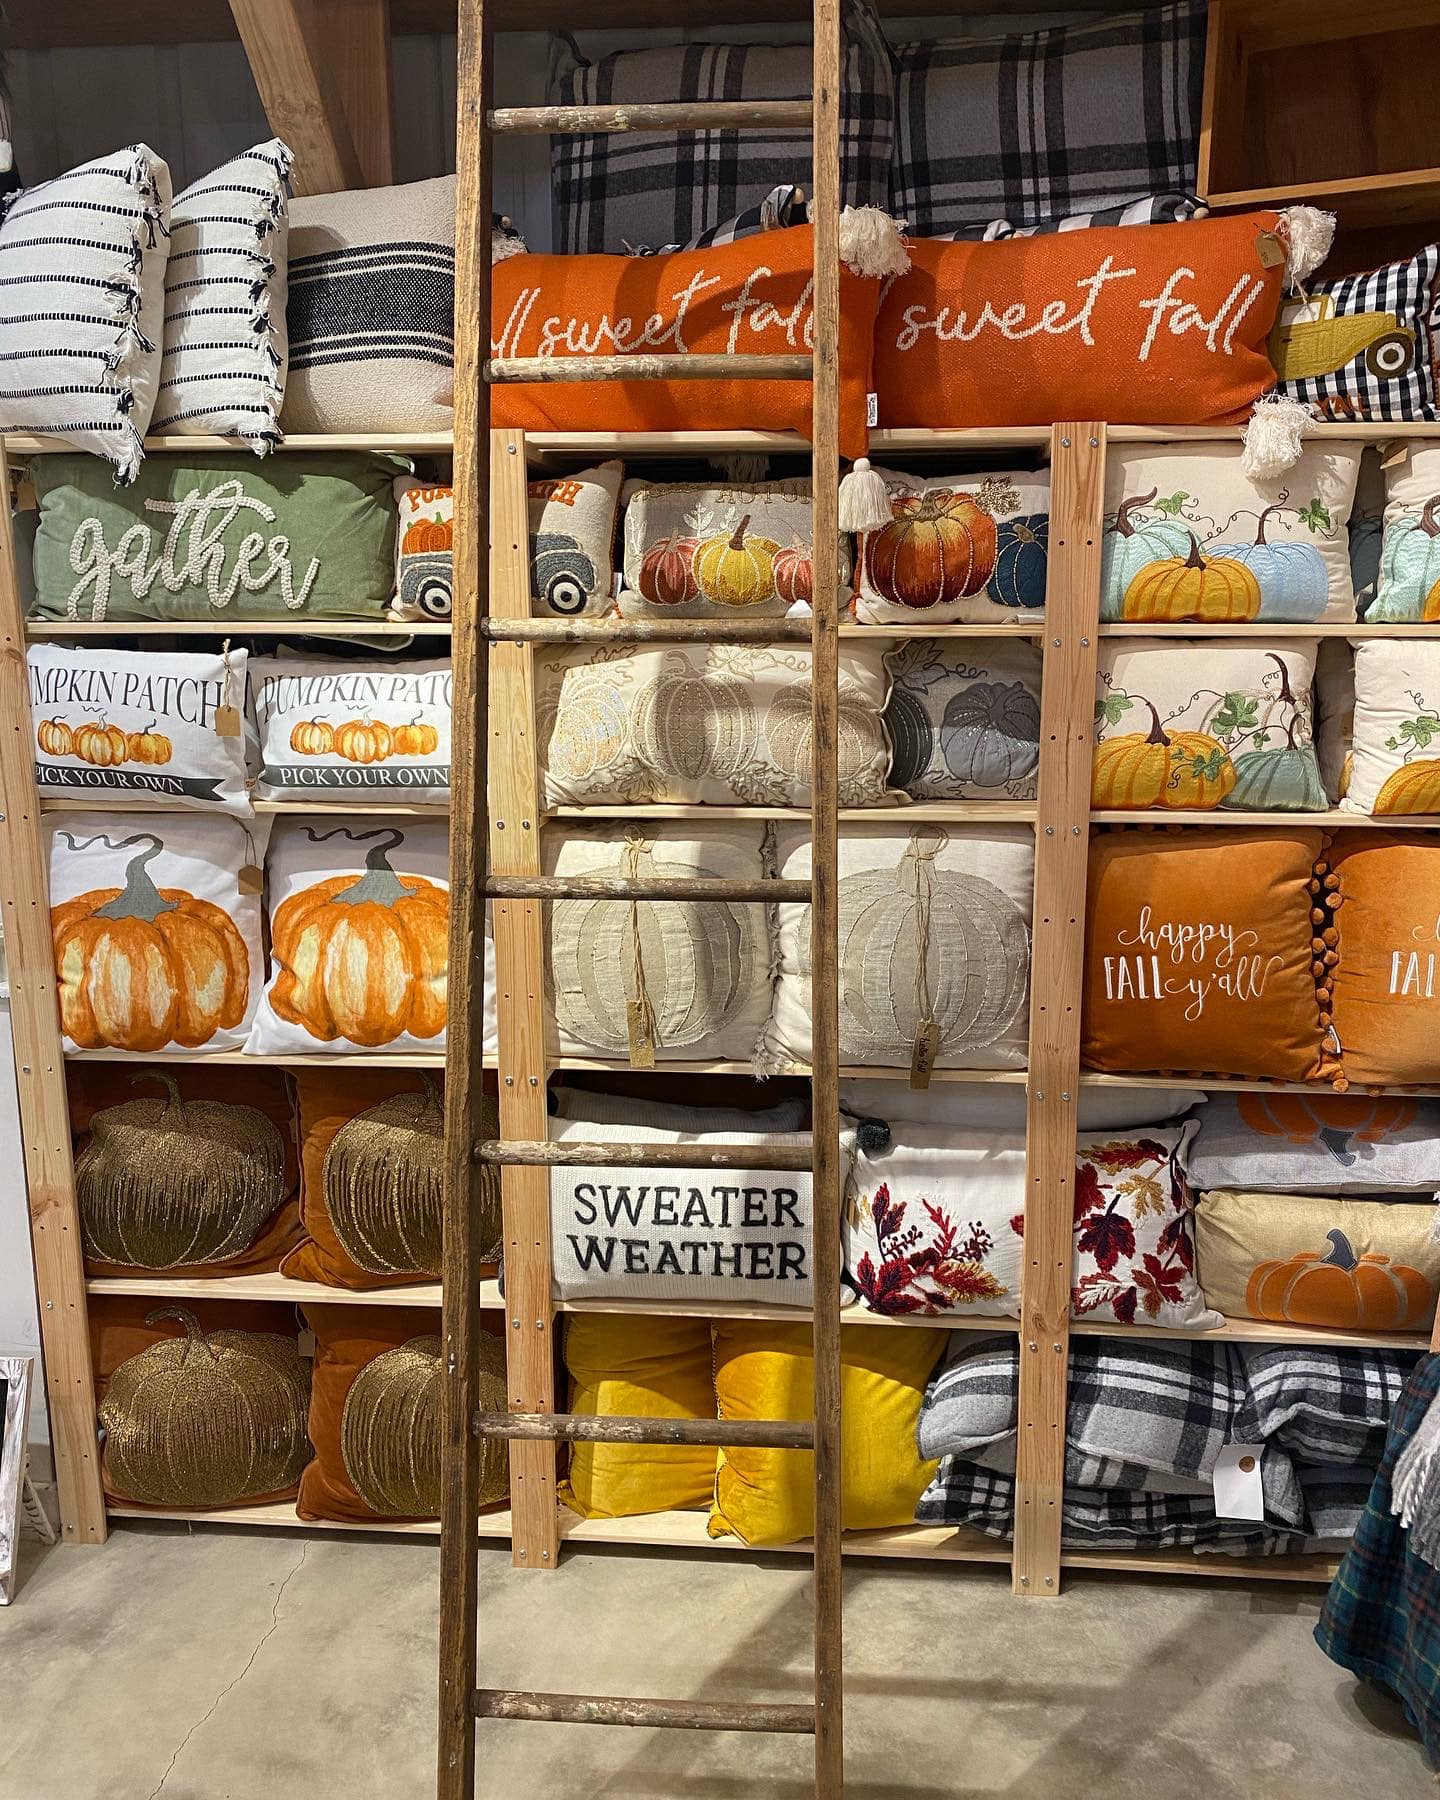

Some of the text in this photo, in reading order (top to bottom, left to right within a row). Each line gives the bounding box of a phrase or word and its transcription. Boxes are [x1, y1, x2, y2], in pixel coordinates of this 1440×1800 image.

[537, 269, 721, 358] sweet
[896, 256, 1136, 351] sweet
[1139, 266, 1264, 362] fall
[66, 479, 320, 622] gather
[263, 674, 382, 724] PUMPKIN
[74, 768, 133, 788] YOUR
[133, 773, 185, 794] OWN
[279, 767, 450, 785] PICK YOUR OWN
[1118, 906, 1258, 967] happy
[1103, 955, 1284, 1021] FALL y'all
[1389, 951, 1437, 998] FAL
[574, 1183, 805, 1228] SWEATER
[566, 1233, 808, 1280] WEATHER
